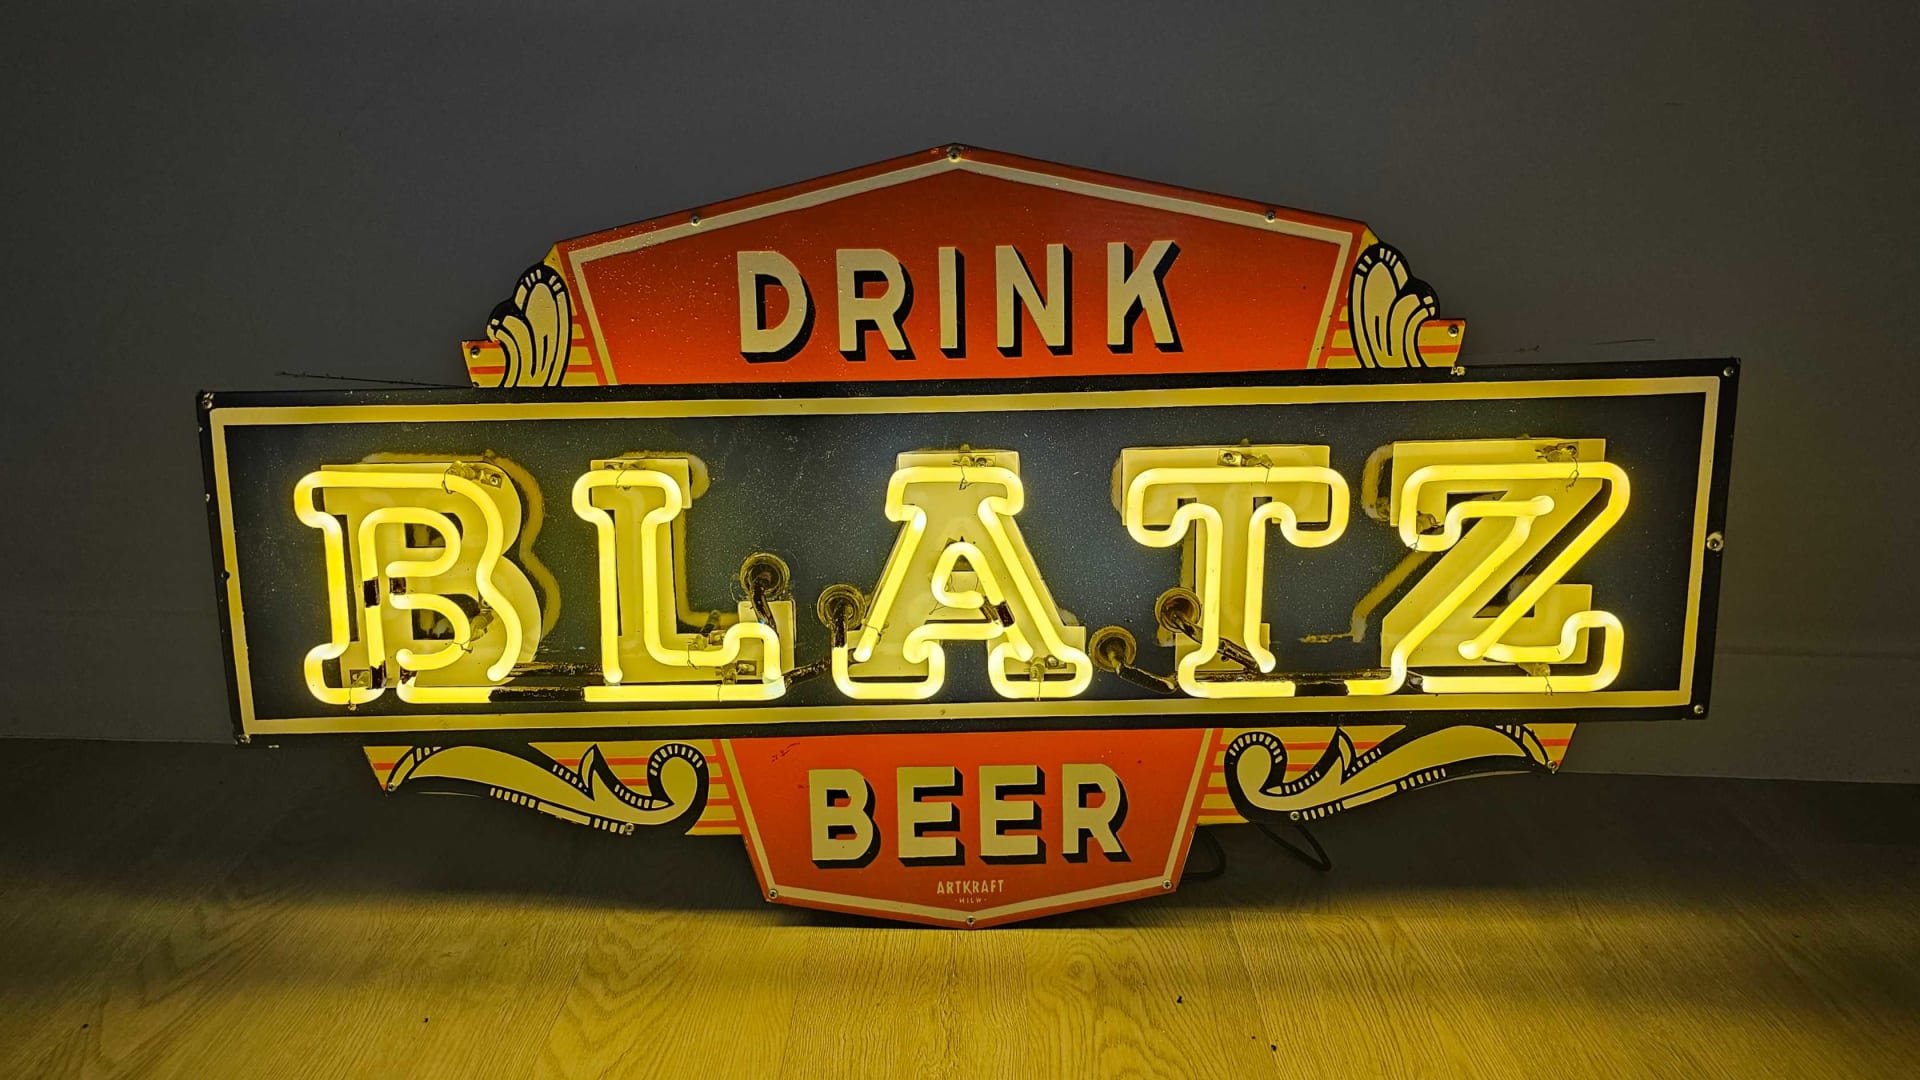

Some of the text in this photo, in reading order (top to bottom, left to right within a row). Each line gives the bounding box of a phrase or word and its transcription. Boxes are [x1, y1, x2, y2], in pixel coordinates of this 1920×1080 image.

[738, 239, 1183, 364] DRINK
[293, 440, 1631, 707] BLATZ
[808, 763, 1131, 868] BEER
[936, 879, 1005, 895] ARTKRAFT
